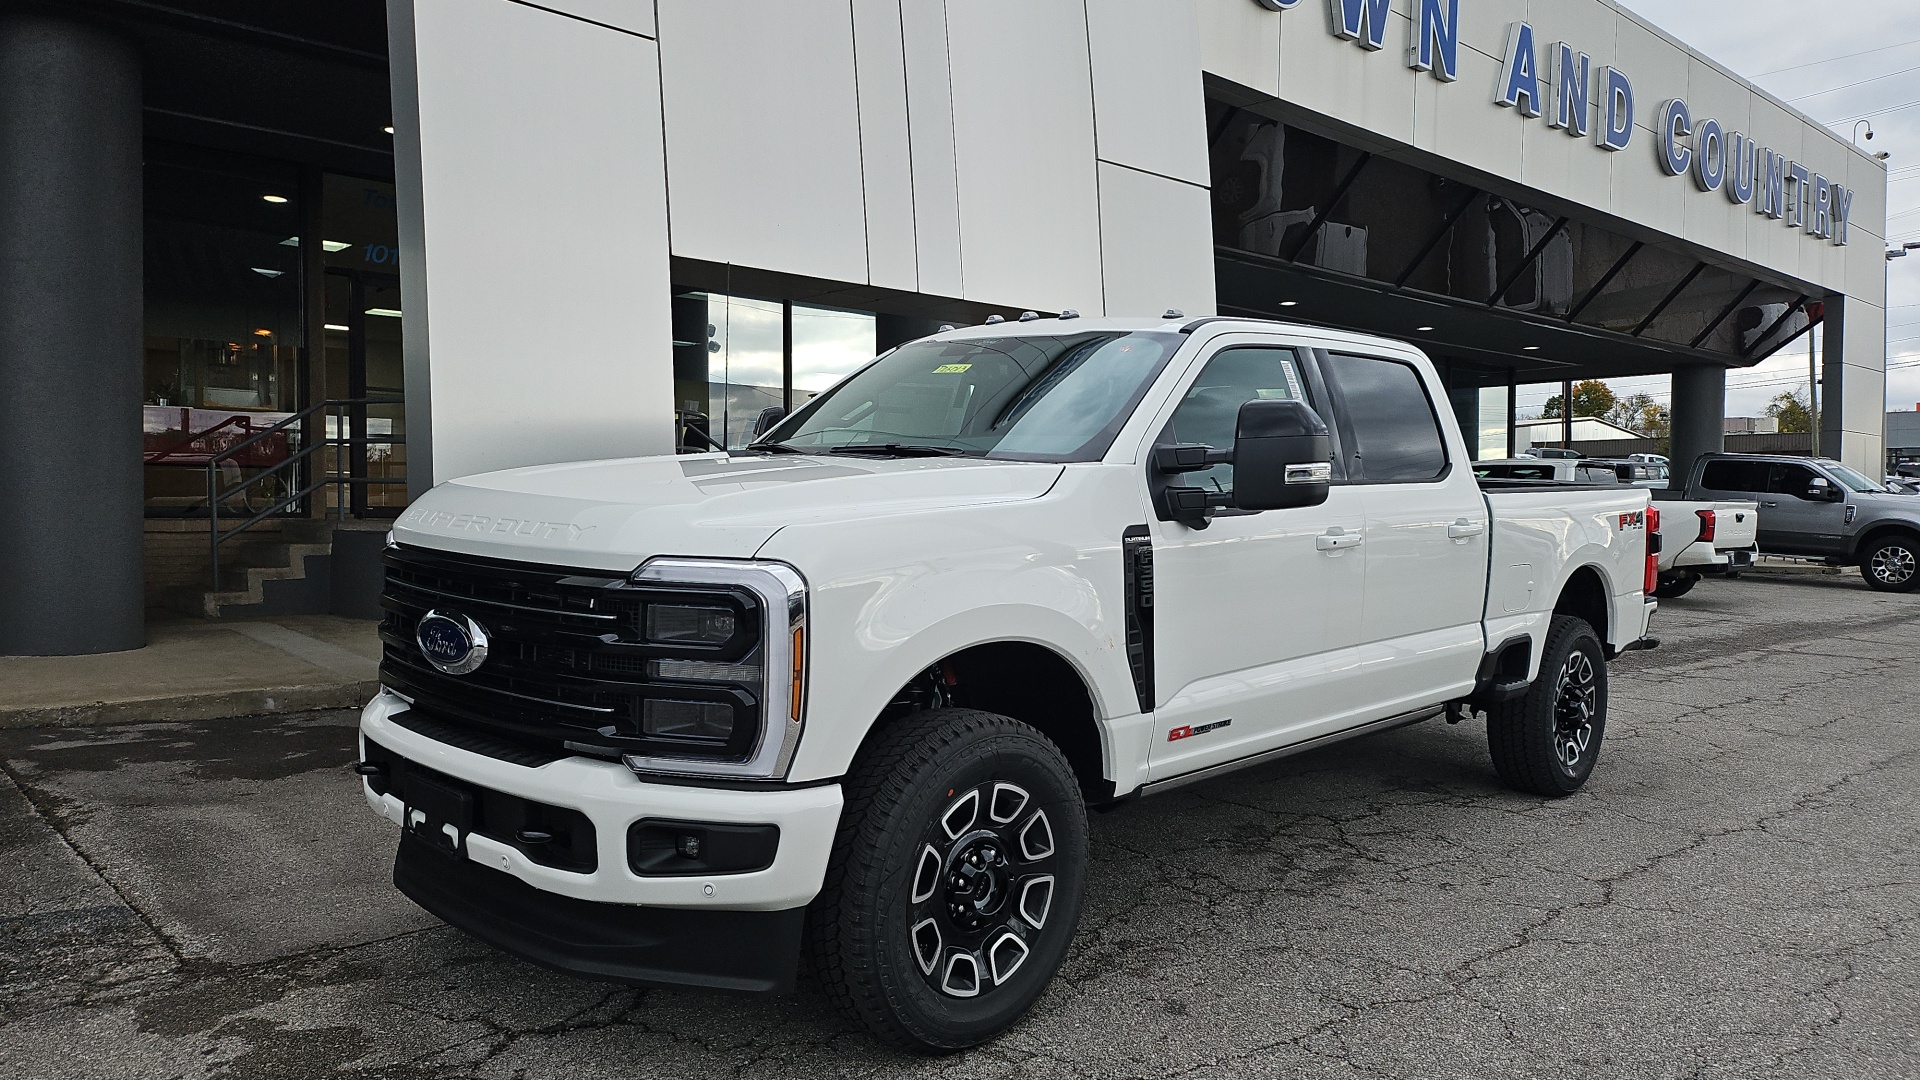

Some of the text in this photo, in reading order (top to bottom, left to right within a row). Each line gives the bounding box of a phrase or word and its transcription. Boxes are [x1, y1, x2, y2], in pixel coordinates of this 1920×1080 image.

[1495, 21, 1635, 151] AND
[1658, 98, 1854, 246] COUNTRY
[405, 508, 601, 542] SUPER DUTY
[1618, 511, 1644, 531] FX4
[426, 625, 457, 656] Ford
